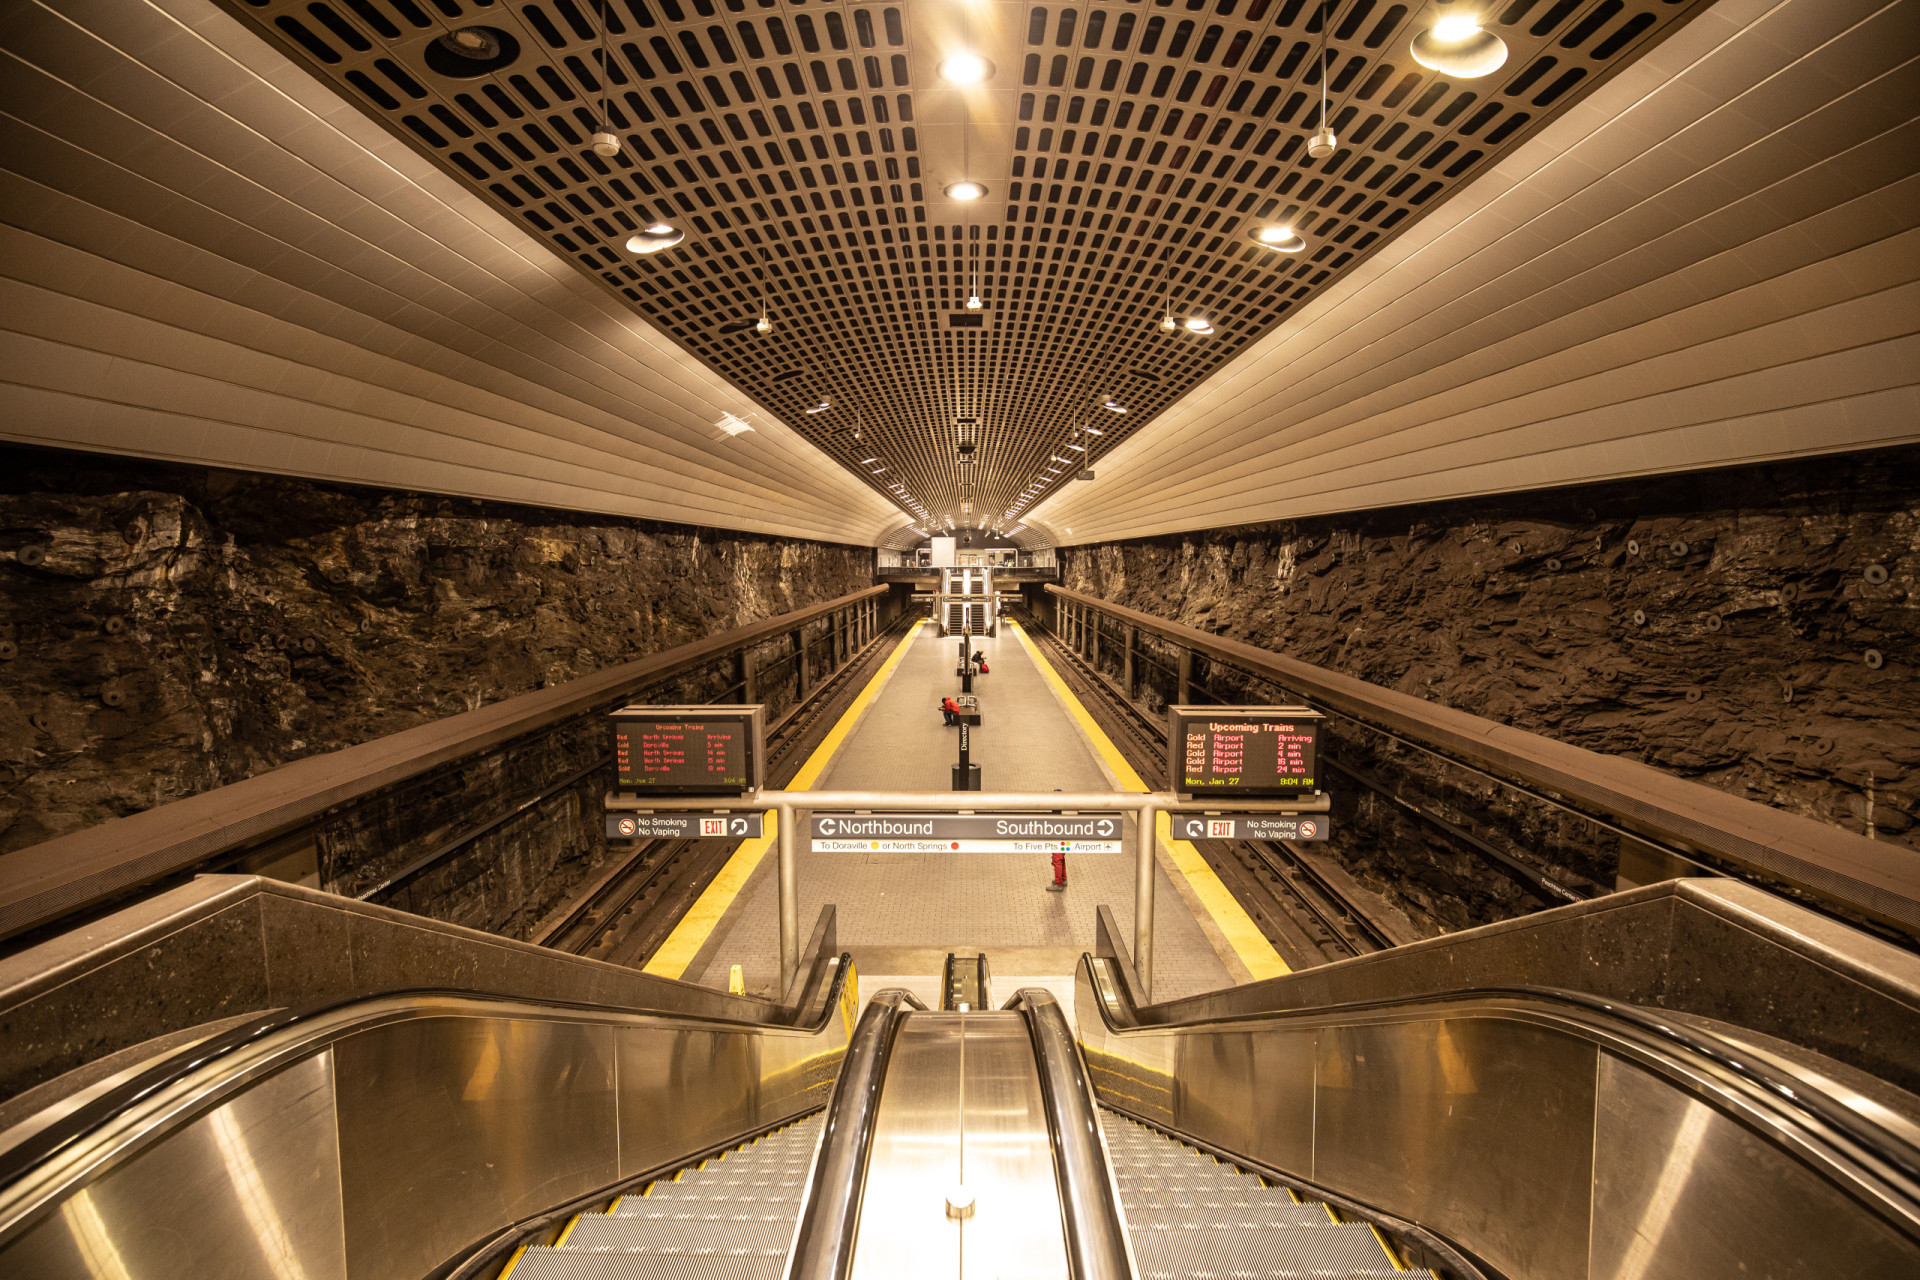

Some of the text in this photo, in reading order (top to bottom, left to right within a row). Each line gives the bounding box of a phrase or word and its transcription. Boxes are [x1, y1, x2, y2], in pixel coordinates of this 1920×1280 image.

[1209, 723, 1259, 733] Upcoming
[1214, 734, 1244, 742] Airport
[1278, 735, 1312, 743] Arriving
[1213, 742, 1243, 751] Airport
[1213, 750, 1243, 759] Airport
[1213, 758, 1243, 766] Airport
[1212, 766, 1242, 774] Airport
[1186, 778, 1205, 786] Mon,
[652, 818, 687, 827] Smoking
[839, 820, 933, 834] Northbound
[1261, 820, 1297, 829] Smoking
[705, 821, 722, 834] EXIT
[996, 820, 1094, 835] Southbound
[1213, 822, 1231, 836] EXIT
[652, 828, 680, 837] Vaping
[1268, 830, 1296, 839] Vaping
[917, 842, 948, 851] Springs
[1074, 843, 1101, 852] Airport
